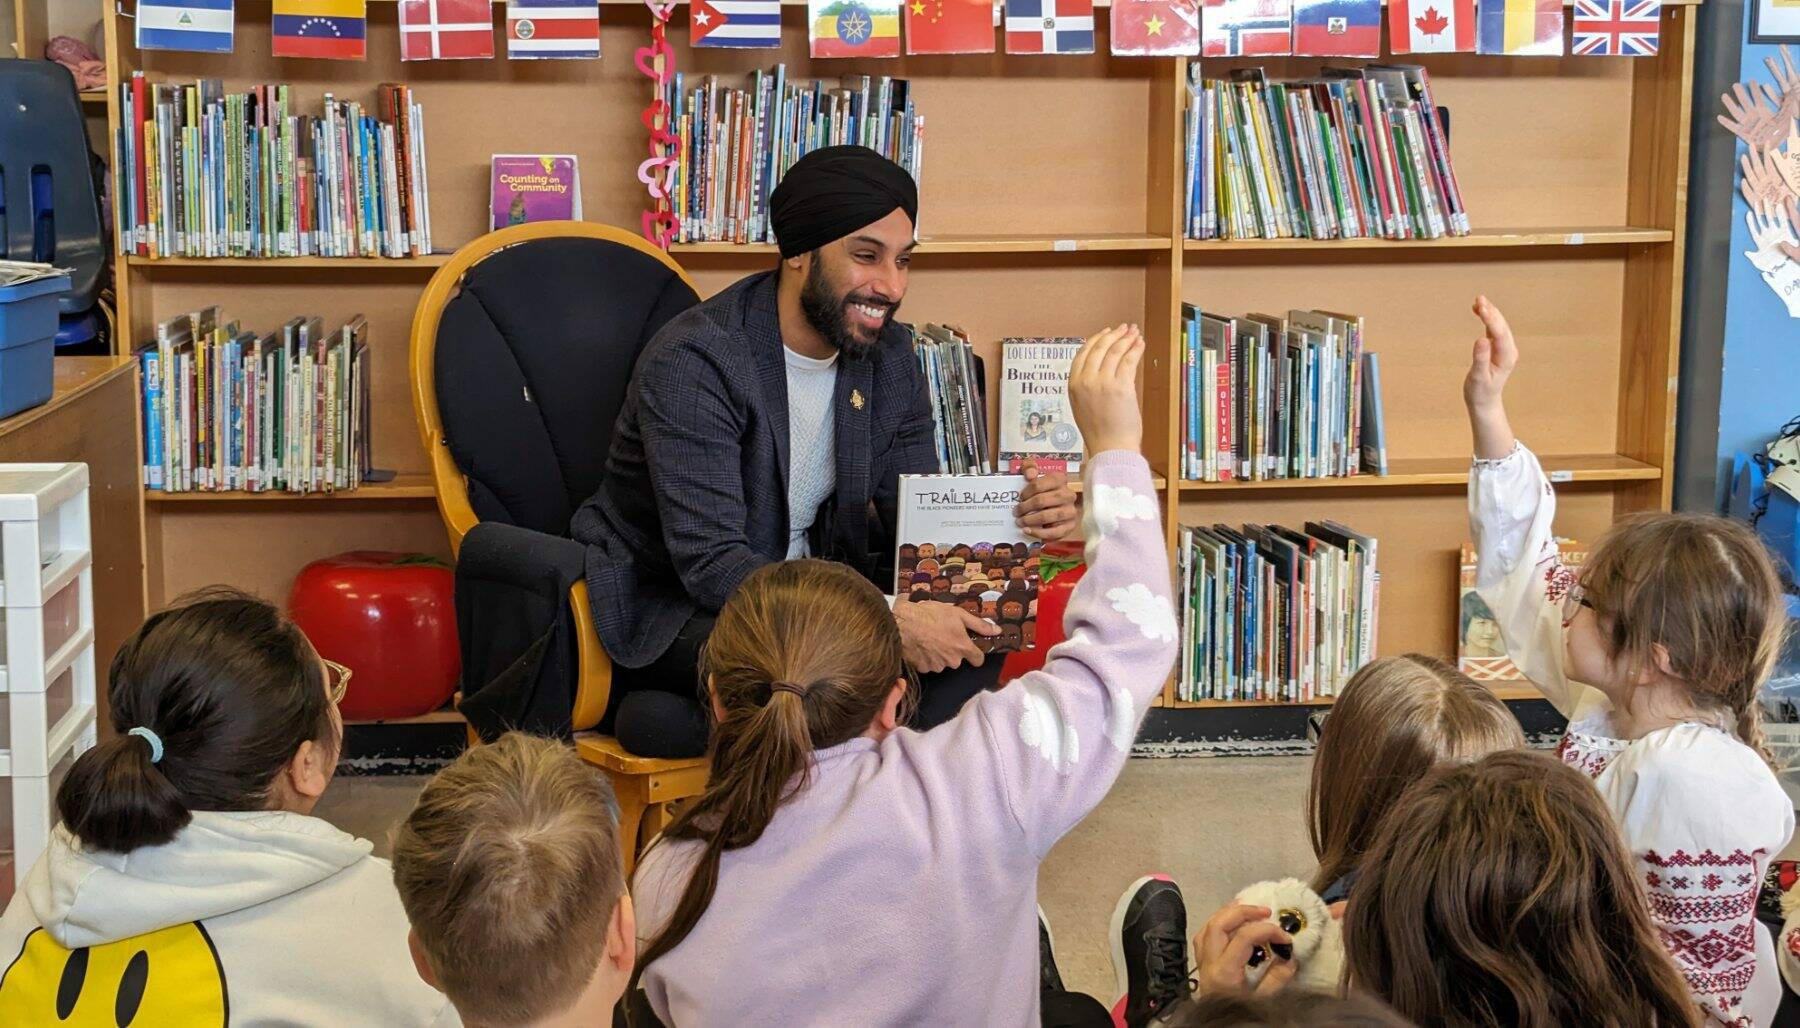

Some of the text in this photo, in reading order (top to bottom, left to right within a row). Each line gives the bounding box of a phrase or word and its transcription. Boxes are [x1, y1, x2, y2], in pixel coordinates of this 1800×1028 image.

[500, 174, 548, 185] Counting
[510, 183, 568, 193] Community
[1007, 347, 1038, 360] LOUISE
[1022, 382, 1064, 394] HOUSE
